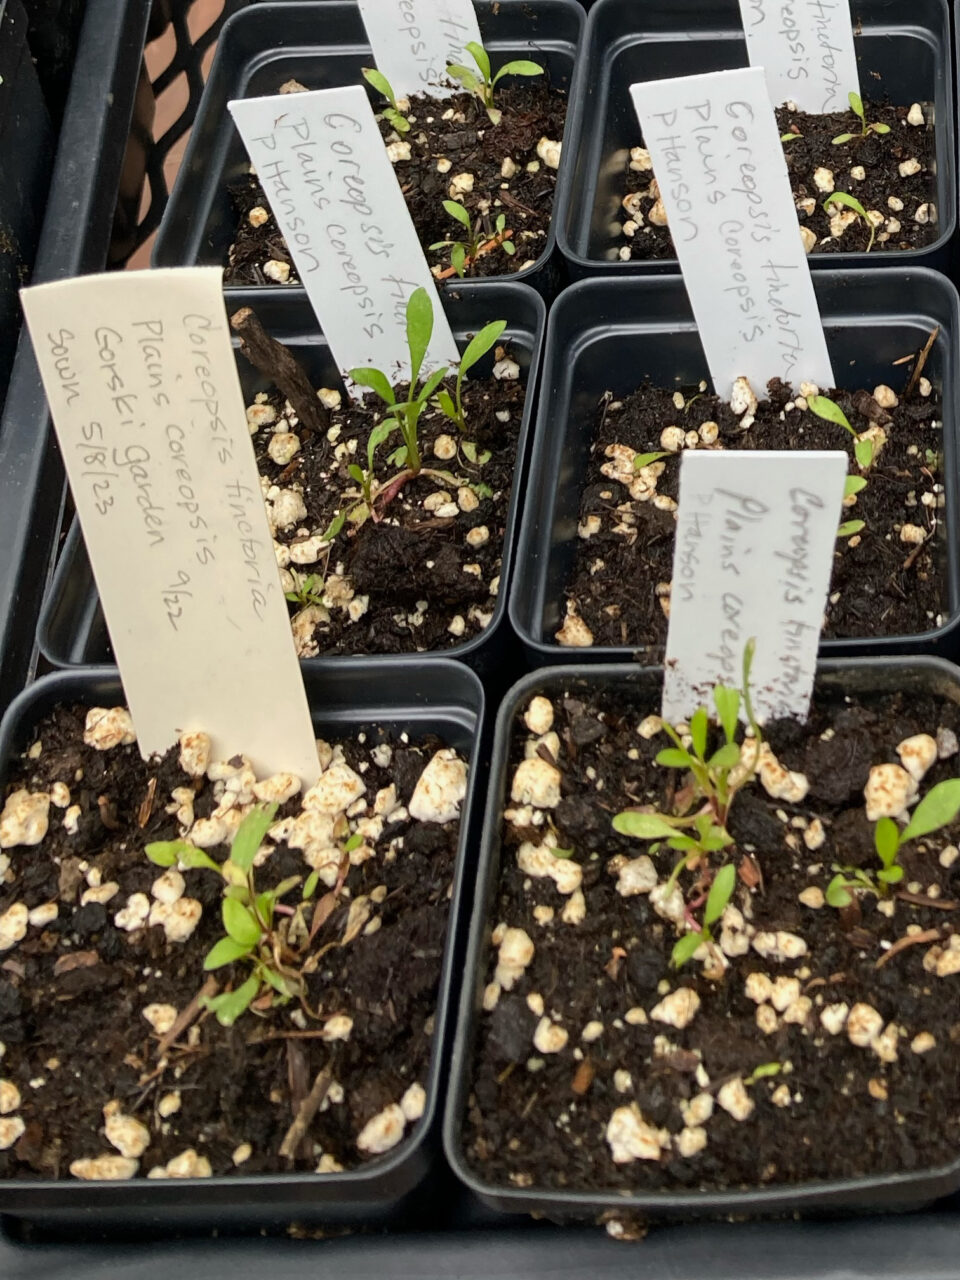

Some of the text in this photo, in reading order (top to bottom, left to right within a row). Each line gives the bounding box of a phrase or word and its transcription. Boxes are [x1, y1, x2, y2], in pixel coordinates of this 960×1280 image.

[806, 0, 851, 112] tinctoria
[287, 116, 344, 210] Plains
[329, 112, 391, 260] Coreopsis
[655, 133, 699, 242] Hanson
[683, 98, 741, 205] Plains
[725, 99, 774, 245] Coreopsis
[261, 159, 320, 273] Hanson
[130, 318, 183, 407] Plains
[46, 327, 119, 516] Sown 5/8/23
[180, 312, 275, 619] Coreopsis tinctoria
[93, 326, 146, 427] Gorski
[160, 569, 193, 631] 9/22
[713, 487, 770, 576] Plains
[679, 511, 711, 602] Hanson
[772, 487, 825, 605] Coreopsis
